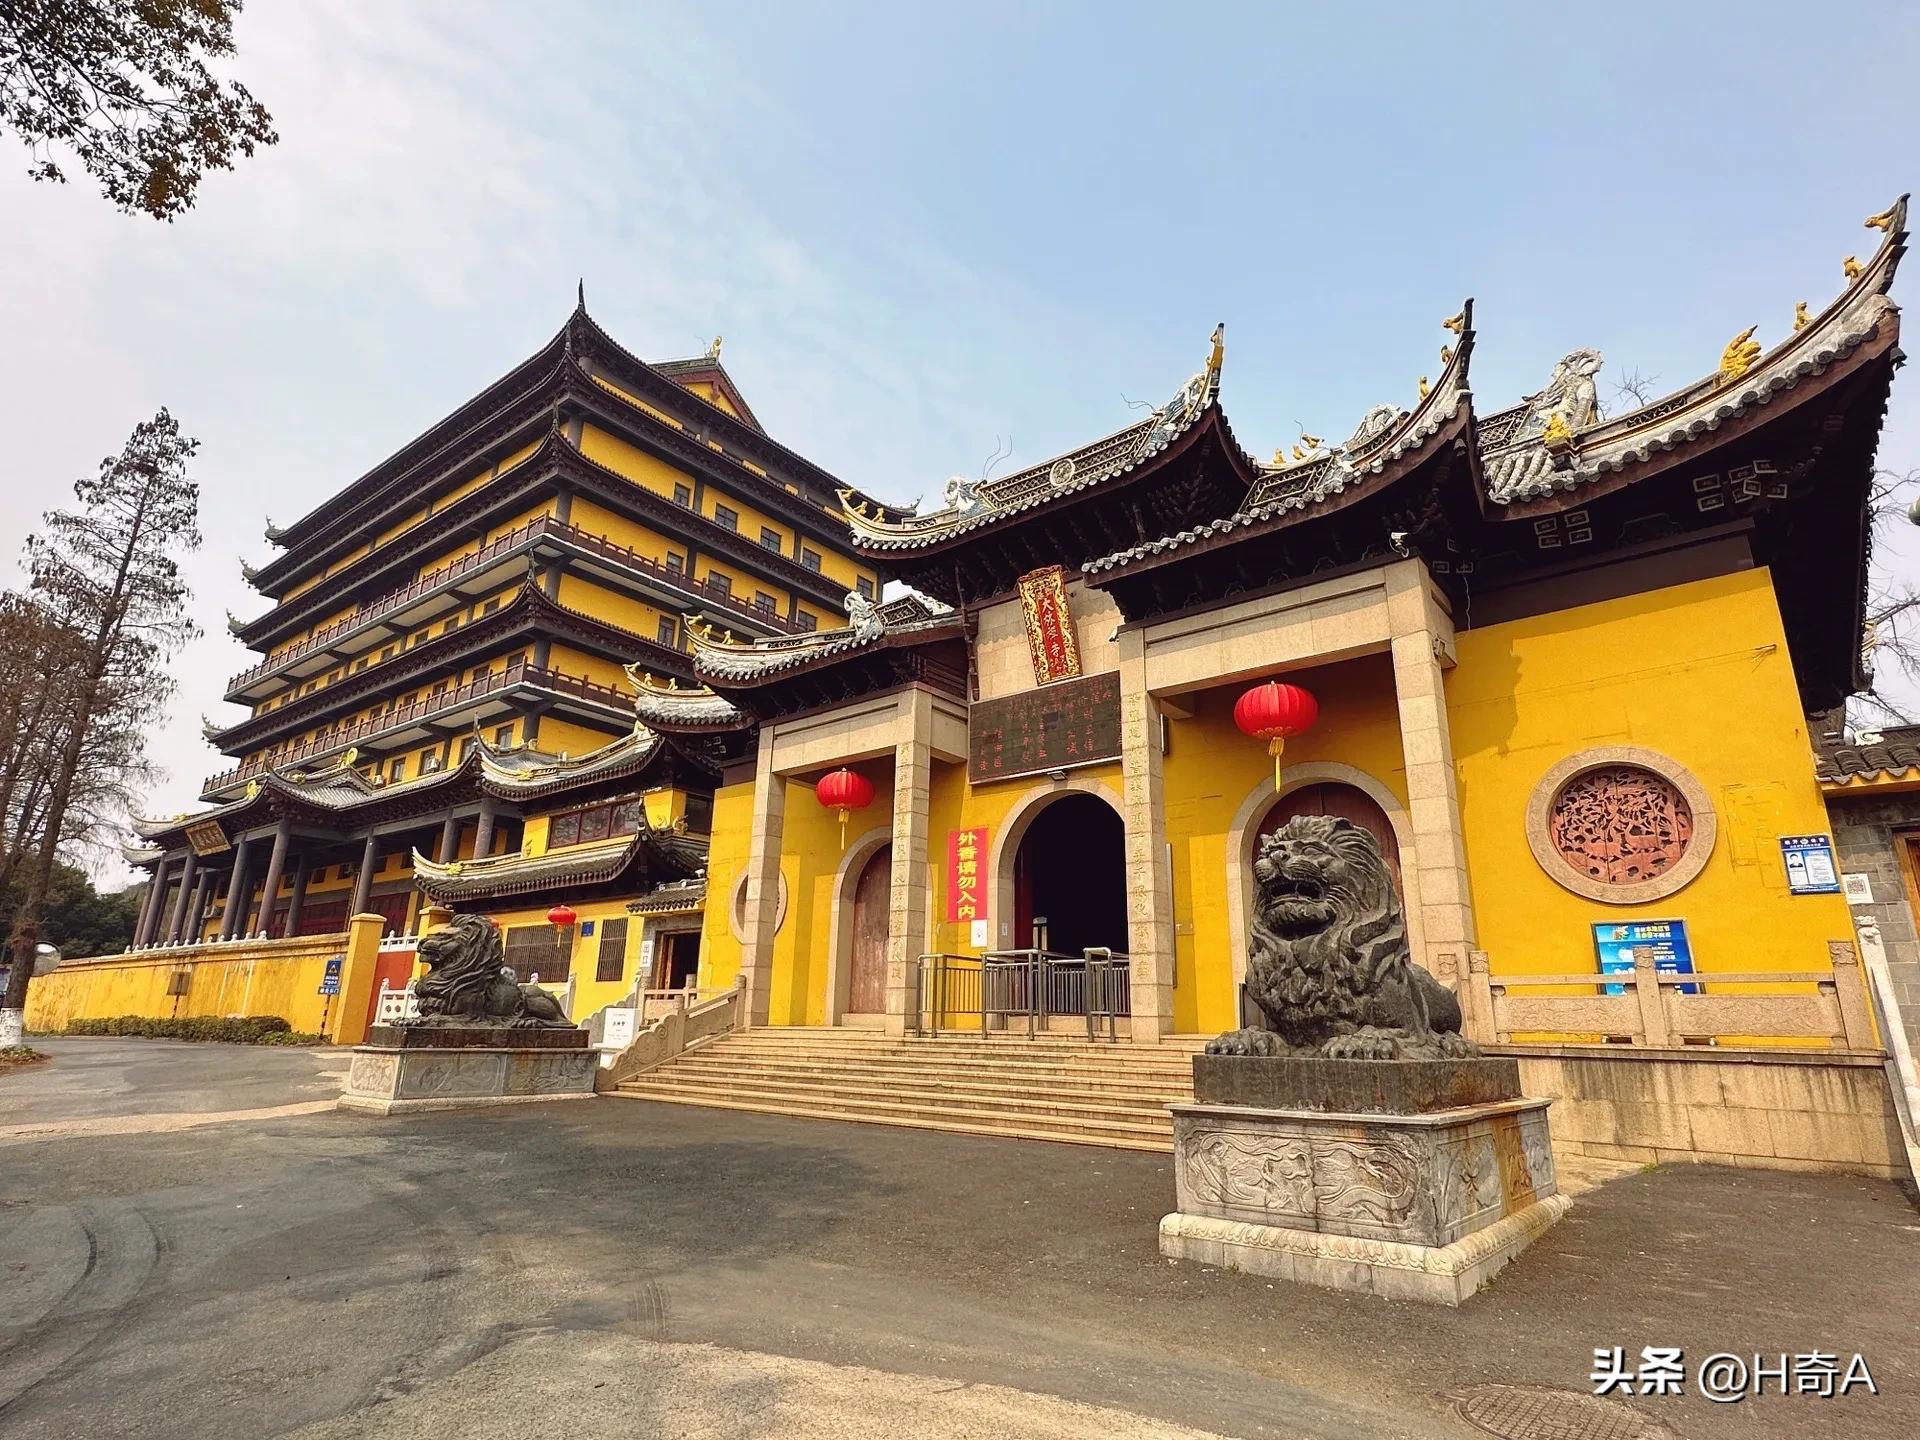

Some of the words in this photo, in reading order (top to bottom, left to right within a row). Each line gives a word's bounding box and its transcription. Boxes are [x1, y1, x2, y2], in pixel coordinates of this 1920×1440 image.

[957, 831, 977, 920] 外香请勿入内
